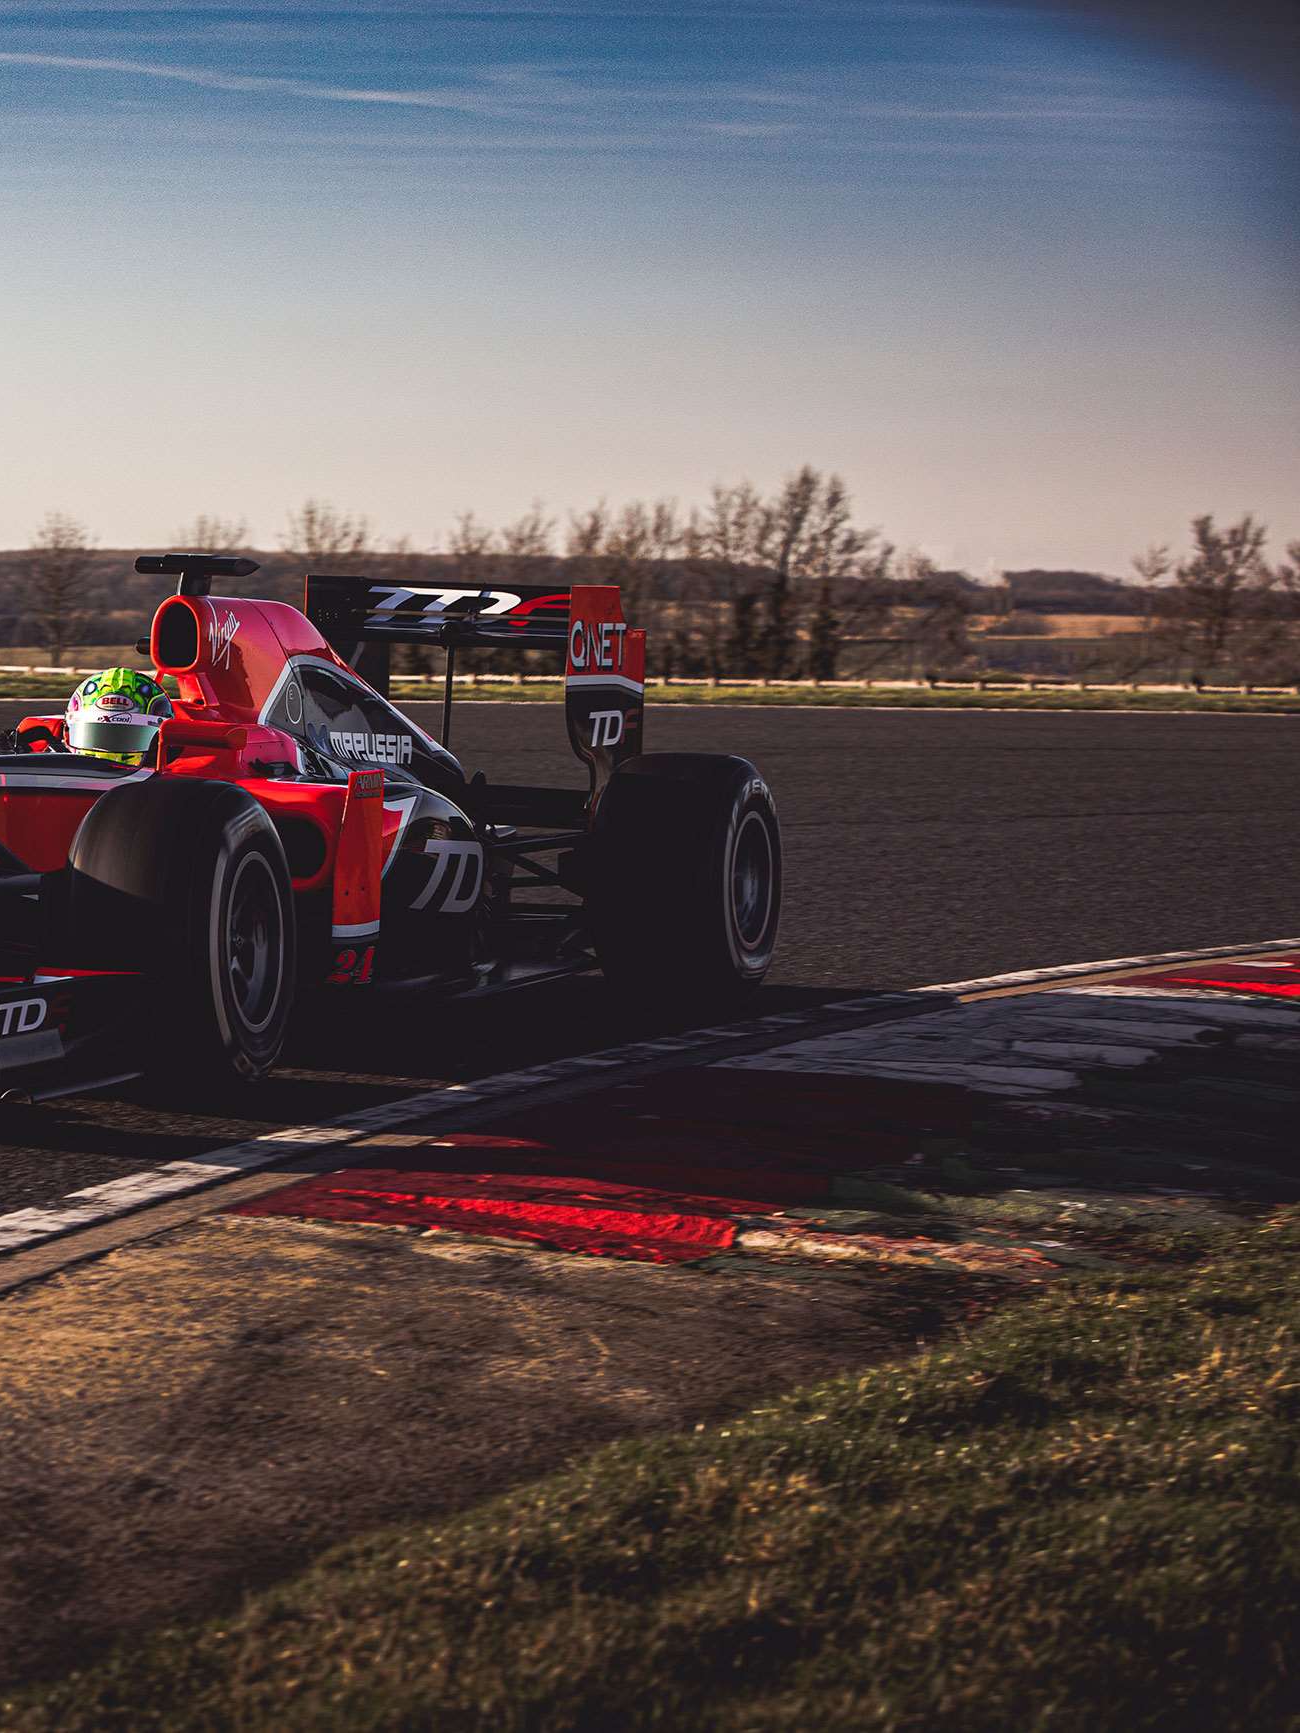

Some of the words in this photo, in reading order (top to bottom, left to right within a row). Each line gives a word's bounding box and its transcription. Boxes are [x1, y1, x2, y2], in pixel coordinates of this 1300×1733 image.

[206, 599, 240, 671] Virgin
[570, 620, 627, 668] QNET
[102, 697, 129, 706] BELL
[408, 839, 484, 913] TD
